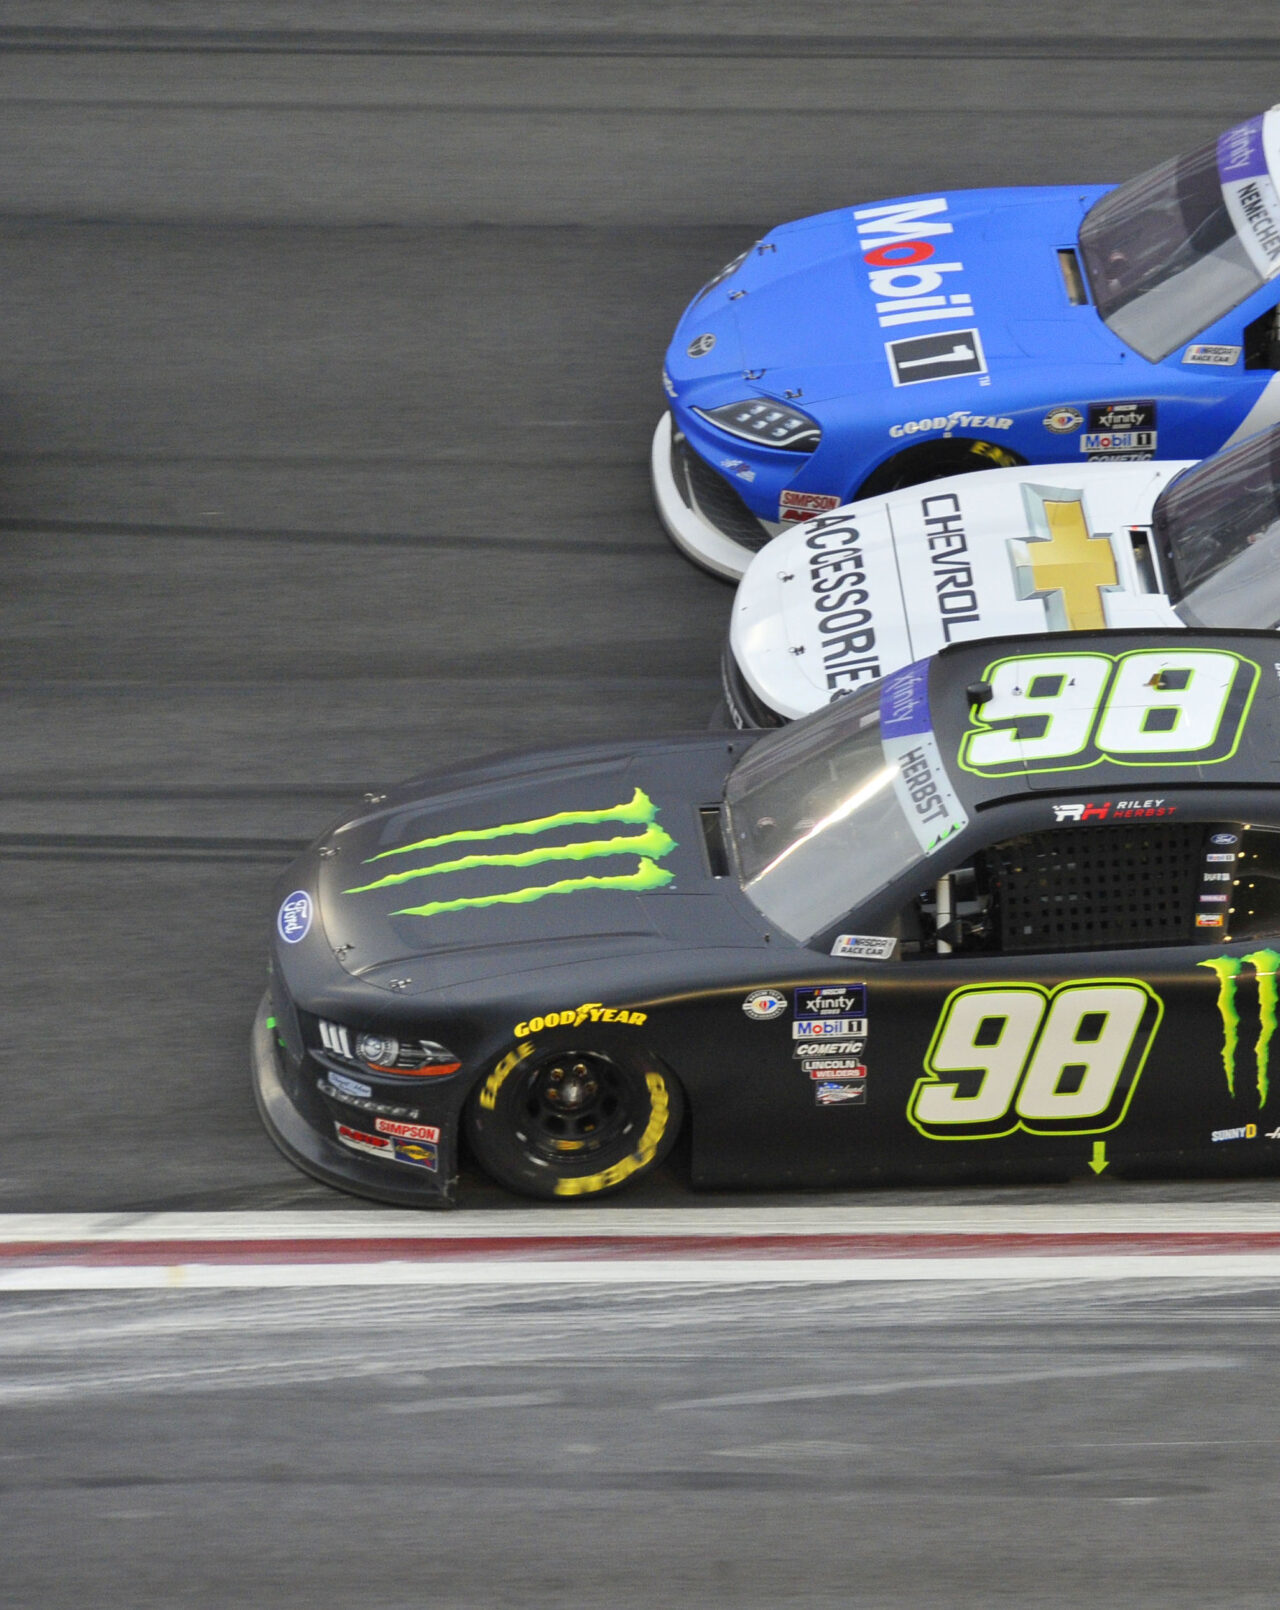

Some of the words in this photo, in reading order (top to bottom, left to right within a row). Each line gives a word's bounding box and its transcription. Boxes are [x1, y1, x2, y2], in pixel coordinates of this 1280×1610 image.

[1223, 126, 1257, 170] xfinity
[853, 197, 976, 328] Mobil
[889, 411, 1014, 438] GOODYEAR
[1098, 411, 1145, 427] xfinity
[1085, 433, 1132, 448] Mobil
[782, 491, 839, 510] SIMPSON
[921, 493, 981, 643] CHEVROL
[884, 672, 924, 725] xfinity
[958, 648, 1262, 778] 98
[899, 746, 950, 825] HERBST
[1113, 807, 1177, 818] HERBST
[1116, 799, 1165, 810] RILEY
[806, 996, 856, 1013] xfinity
[513, 1003, 648, 1038] GOODYEAR
[797, 1021, 843, 1034] Mobil
[797, 1042, 863, 1055] COMETIC
[805, 1060, 856, 1070] LINCOLN
[907, 978, 1164, 1141] 98
[815, 1069, 861, 1079] WELDERS
[379, 1120, 435, 1140] SIMPSON
